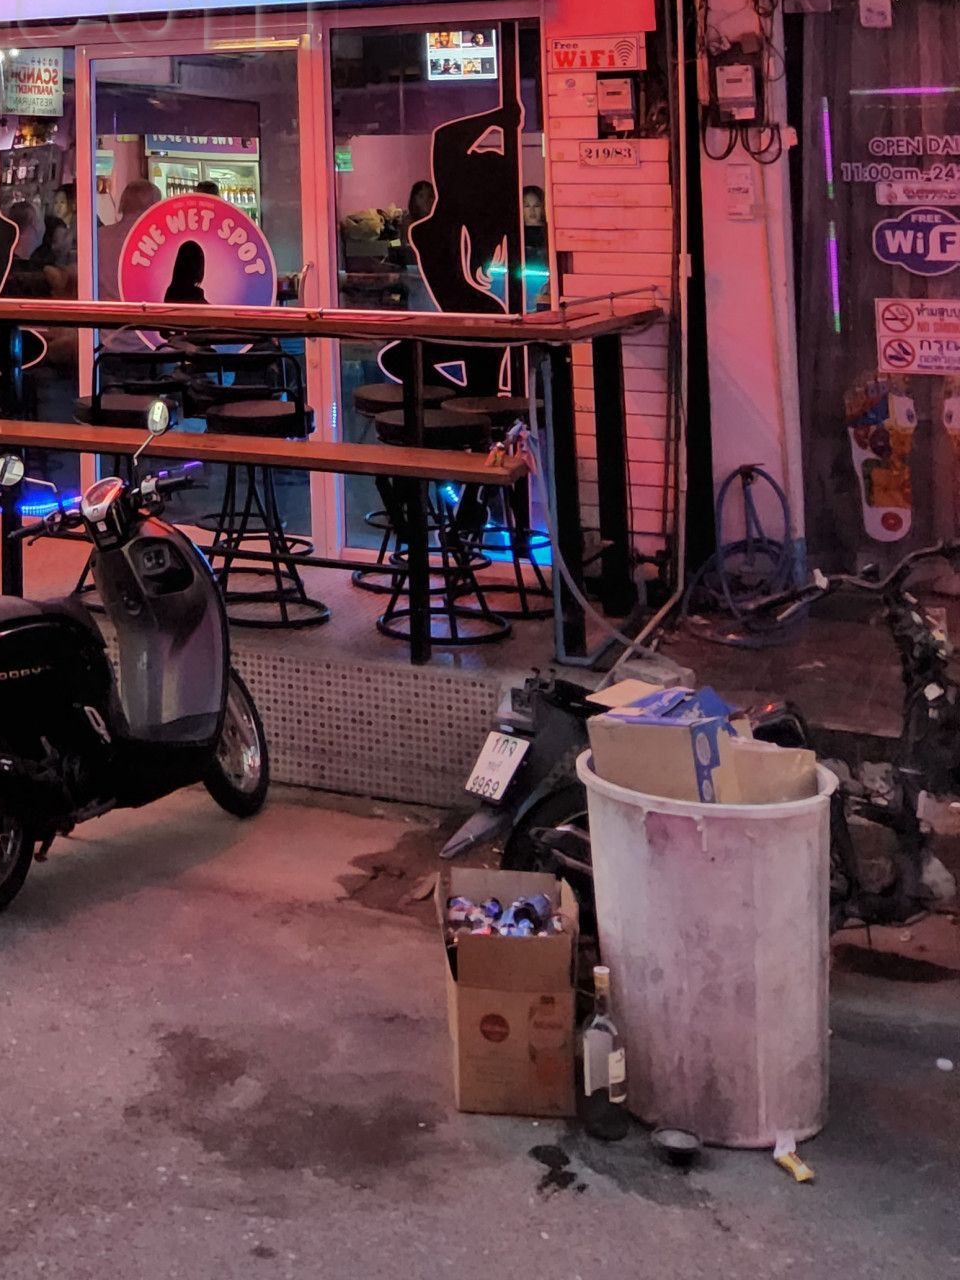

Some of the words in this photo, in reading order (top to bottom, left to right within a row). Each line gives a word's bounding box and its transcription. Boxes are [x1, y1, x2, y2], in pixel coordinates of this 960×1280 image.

[555, 49, 616, 67] WiFi
[869, 137, 922, 155] OPEN
[911, 214, 942, 223] FREE
[131, 224, 166, 267] THE
[165, 208, 215, 234] WET
[217, 218, 266, 275] SPOT
